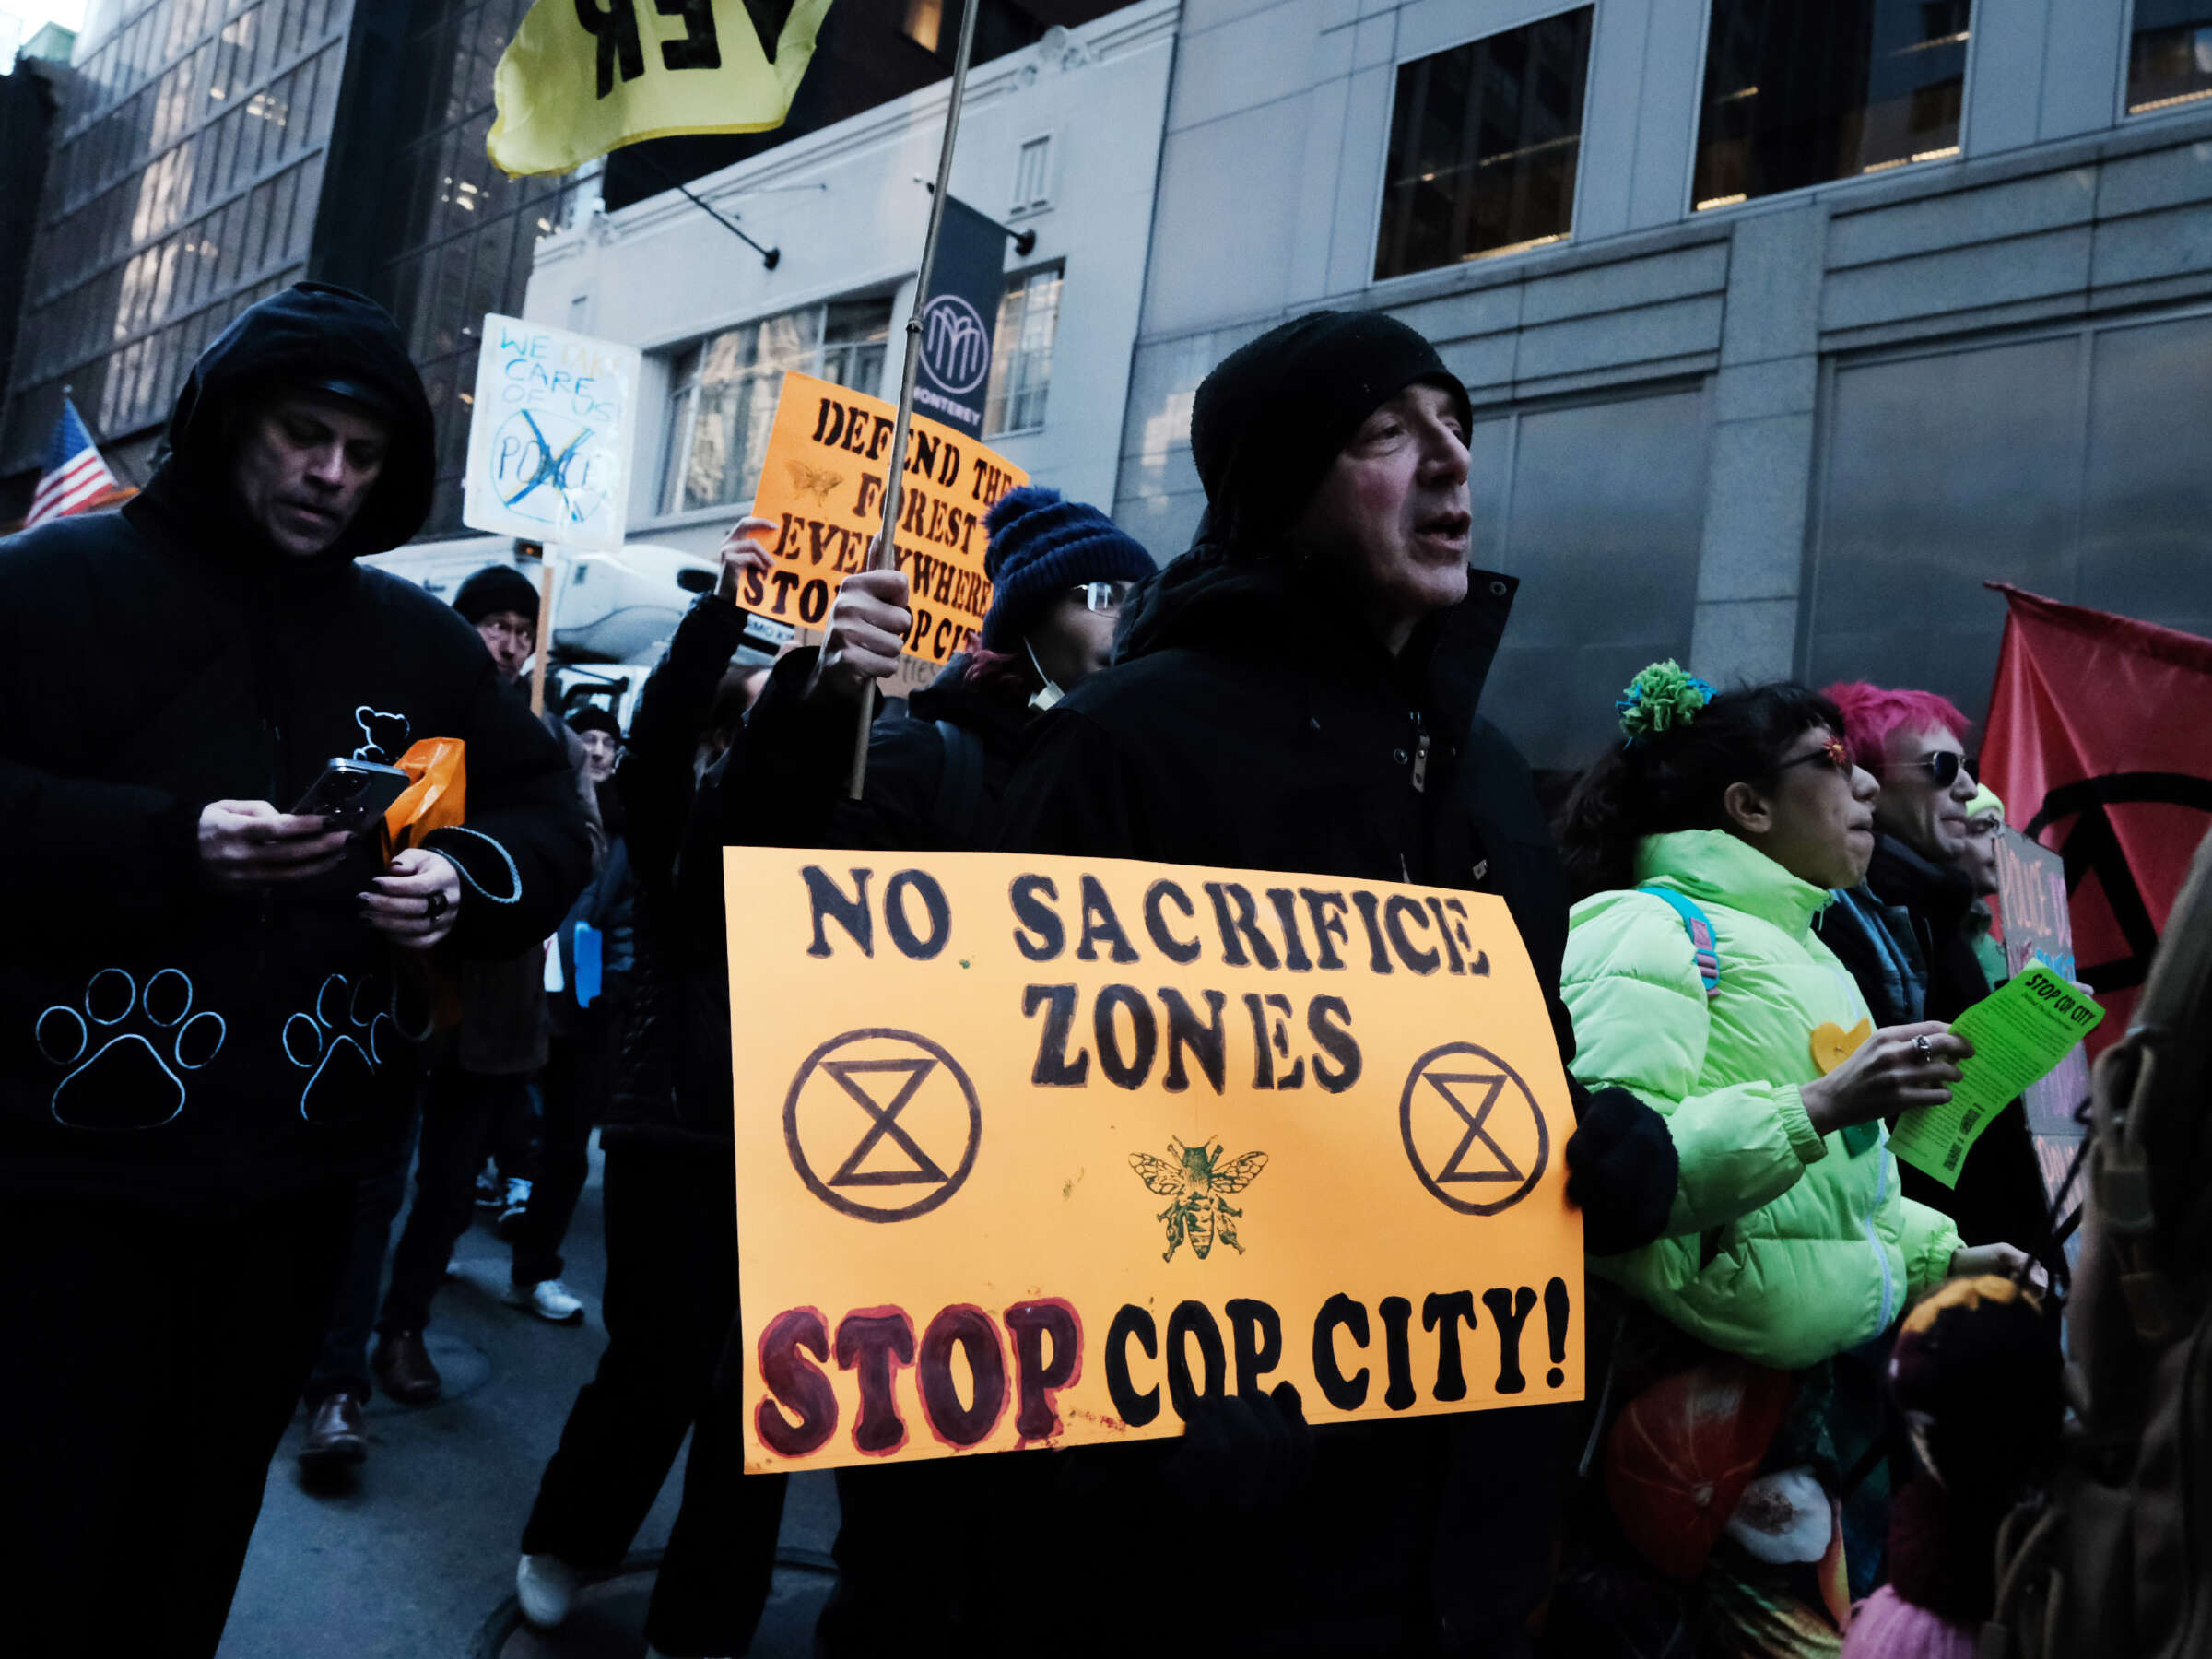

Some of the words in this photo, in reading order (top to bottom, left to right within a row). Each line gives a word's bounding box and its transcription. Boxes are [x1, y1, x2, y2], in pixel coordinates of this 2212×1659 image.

[501, 327, 550, 359] WE
[502, 383, 545, 404] OF
[572, 395, 615, 423] US
[505, 358, 595, 396] CARE
[743, 564, 840, 624] STO
[798, 865, 952, 961] NO
[1007, 872, 1490, 979] SACRIFICE
[2025, 973, 2061, 1000] STOP
[2070, 1005, 2096, 1026] CITY
[1021, 982, 1362, 1095] ZONES
[754, 1295, 1084, 1458] STOP
[1105, 1299, 1282, 1427] COP
[1312, 1277, 1571, 1411] CITY!
